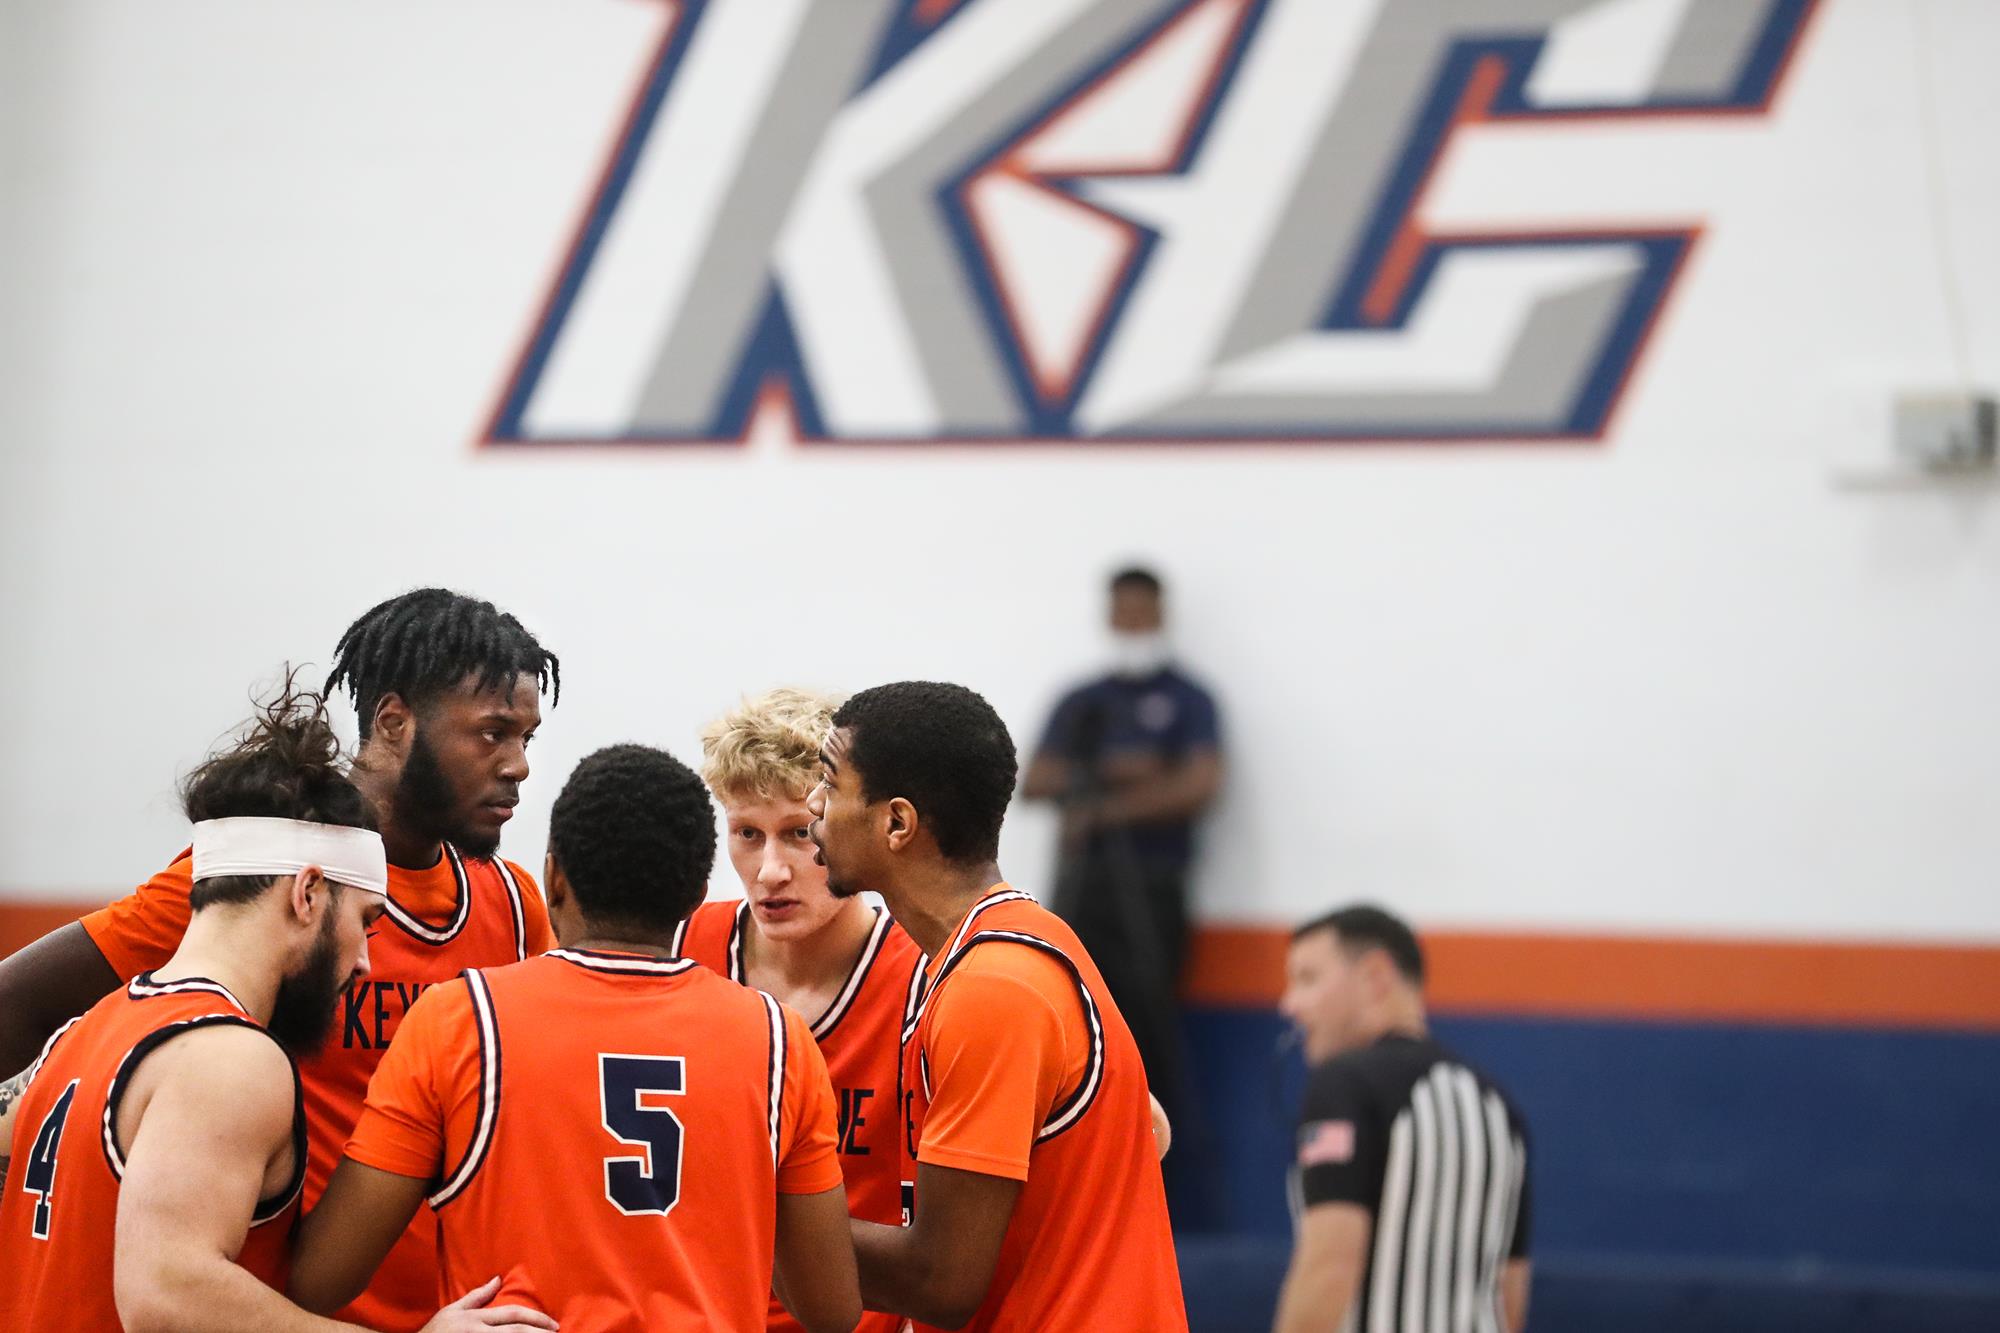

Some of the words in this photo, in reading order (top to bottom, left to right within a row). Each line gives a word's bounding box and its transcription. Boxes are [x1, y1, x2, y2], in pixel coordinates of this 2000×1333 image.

[343, 981, 433, 1049] KEY
[23, 1078, 80, 1240] 4
[598, 1053, 686, 1216] 5
